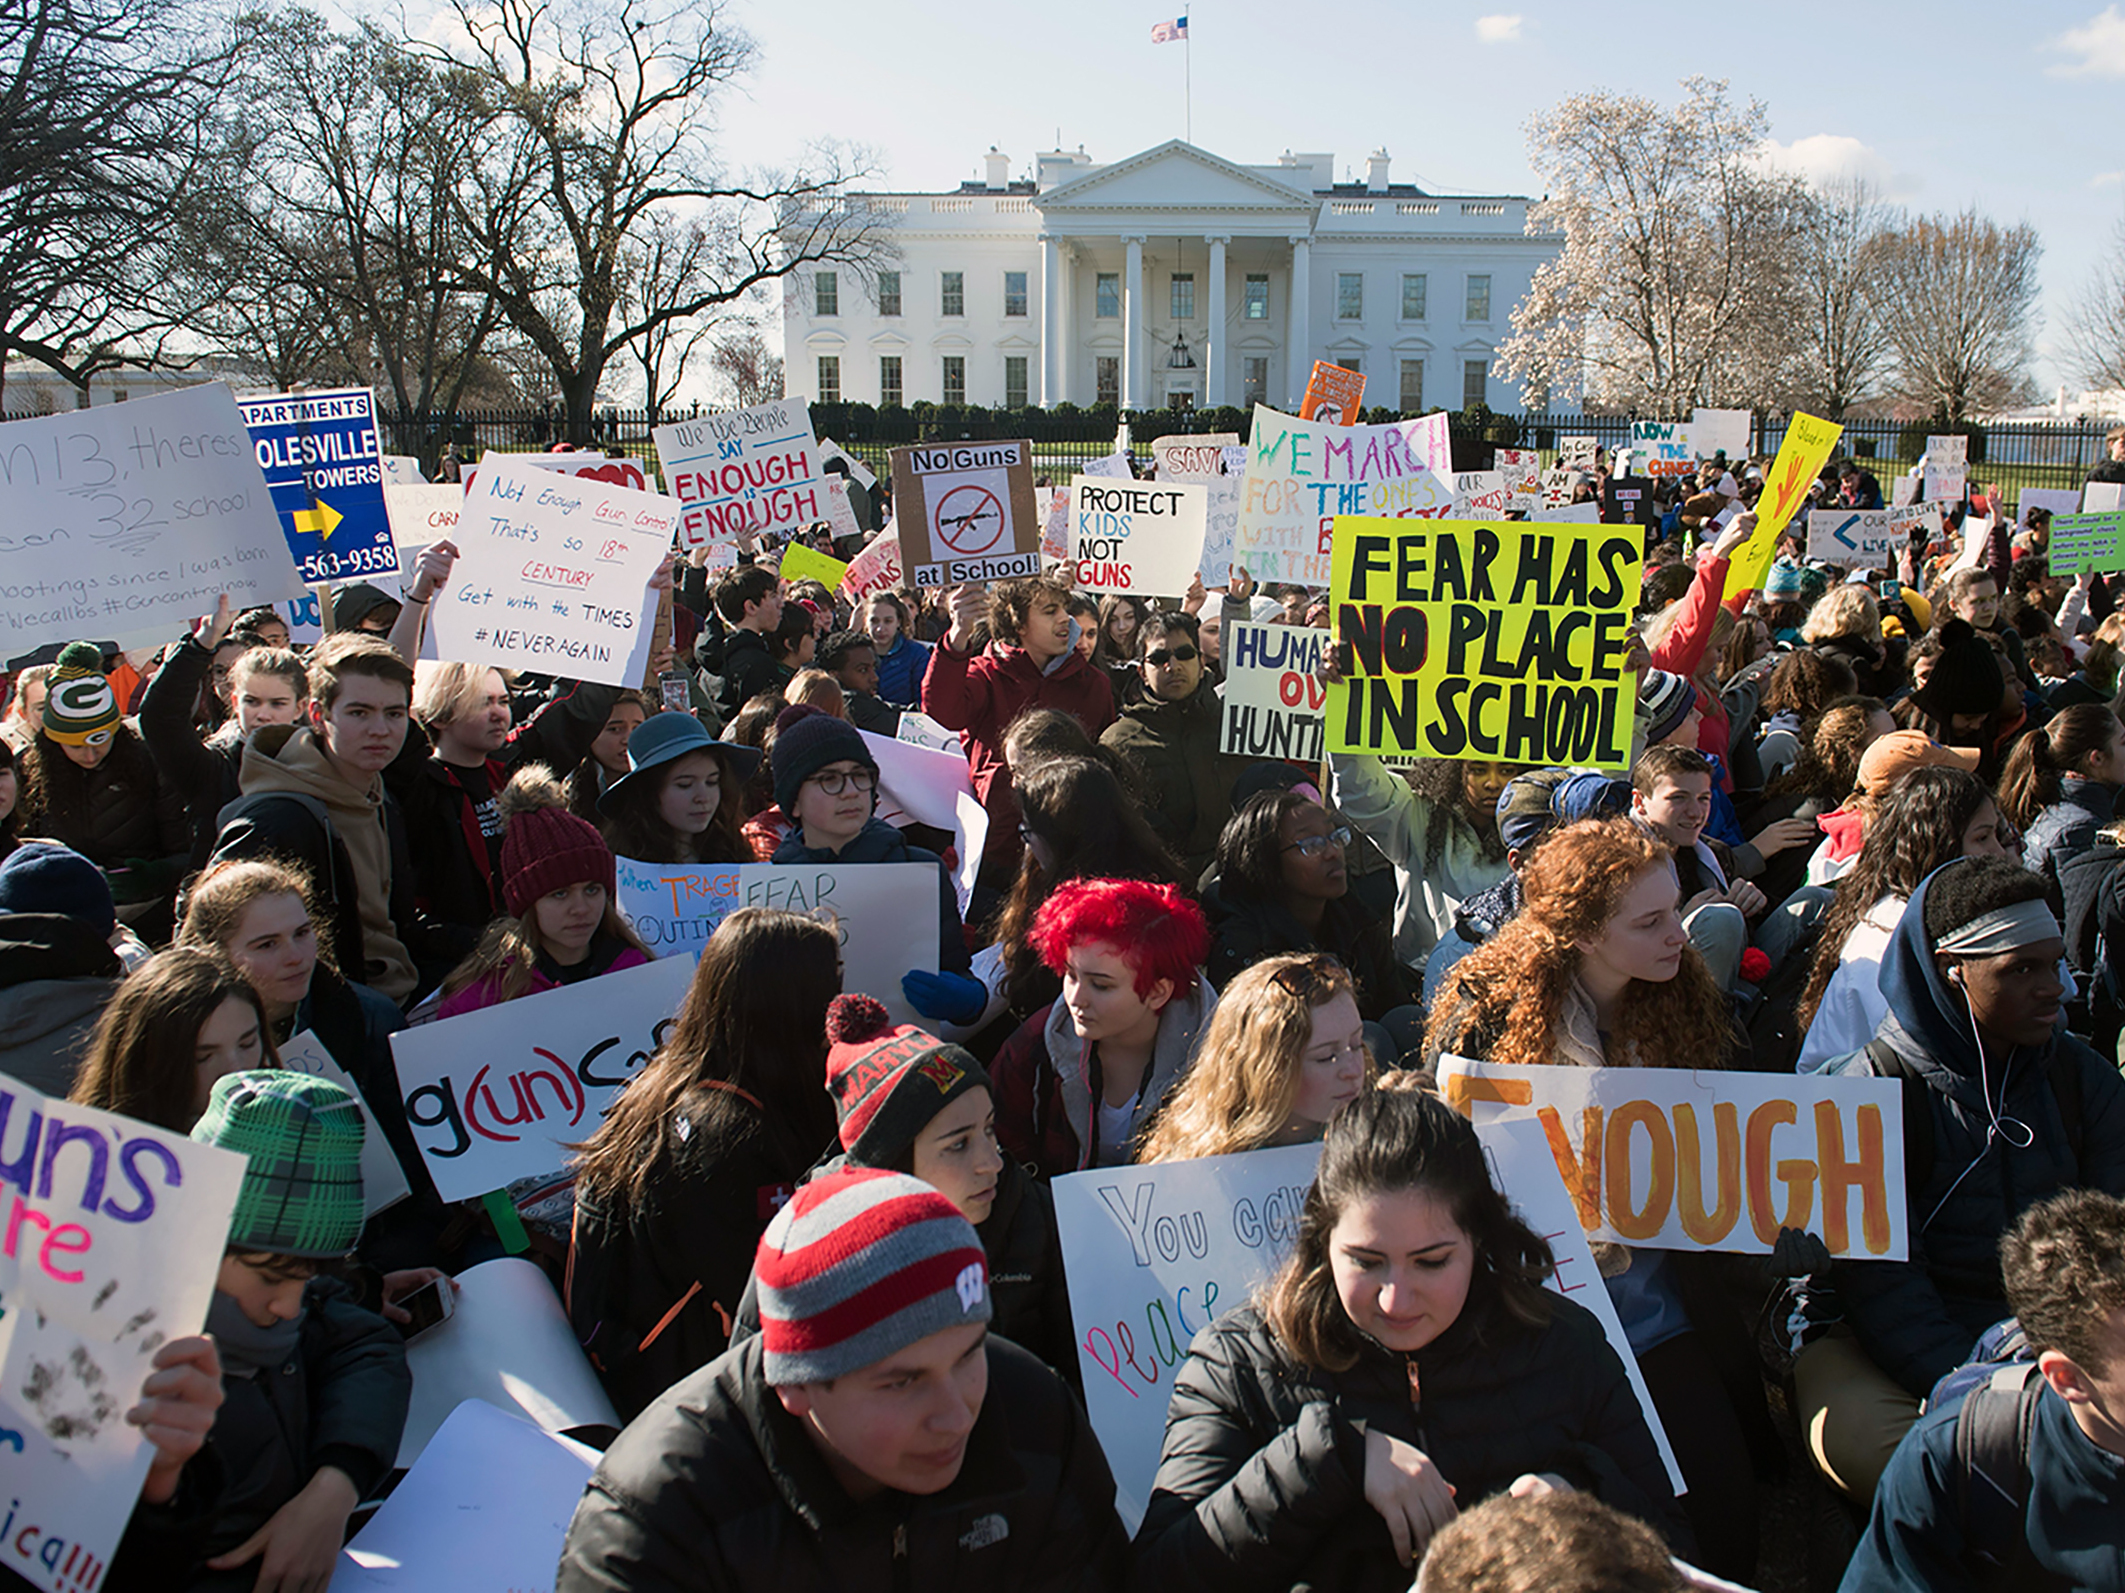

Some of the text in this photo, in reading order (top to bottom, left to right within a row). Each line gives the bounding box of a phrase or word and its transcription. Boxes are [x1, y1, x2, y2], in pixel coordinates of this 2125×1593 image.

[675, 425, 704, 448] We
[737, 405, 790, 435] People
[1634, 422, 1675, 440] NOW
[129, 426, 242, 469] theres
[255, 430, 378, 469] OLESVILLE
[717, 439, 743, 460] SAY
[912, 449, 1017, 471] No Guns
[1256, 422, 1311, 476] WE
[1325, 416, 1447, 480] MARCH
[302, 464, 381, 490] TOWERS
[675, 451, 810, 503] ENOUGH
[1548, 473, 1569, 487] AM
[1648, 459, 1698, 476] CHANGE
[489, 476, 526, 502] Not
[537, 488, 582, 515] Enough
[595, 500, 627, 520] Gun
[1246, 478, 1303, 516] FOR
[1307, 483, 1368, 515] THE
[1372, 478, 1436, 510] ONES
[1458, 474, 1485, 492] OUR
[1550, 490, 1561, 501] I
[89, 494, 169, 541] 32
[173, 489, 251, 521] school
[1080, 485, 1184, 516] PROTECT
[1470, 489, 1503, 512] VOICES
[1915, 502, 1937, 515] LIVE
[683, 488, 818, 544] ENOUGH
[1079, 513, 1132, 537] KIDS
[1863, 515, 1887, 527] OUR
[2078, 516, 2100, 524] should
[490, 516, 629, 560] That's so 18th
[1243, 525, 1303, 547] WITH
[1863, 539, 1888, 553] LIVE
[2053, 528, 2092, 537] background
[296, 545, 396, 578] -563-9358
[1078, 538, 1123, 561] NOT
[1240, 550, 1279, 578] IN
[2053, 551, 2078, 559] allowed
[2093, 549, 2106, 557] buy
[107, 570, 170, 587] since
[180, 562, 185, 579] I
[191, 556, 232, 574] was
[235, 546, 270, 564] born
[521, 560, 595, 588] CENTURY
[917, 566, 939, 585] at
[952, 555, 1038, 581] School!
[1349, 529, 1500, 602] FEAR
[1510, 533, 1640, 608] HAS
[0, 606, 98, 630] Wecallbs
[458, 583, 633, 629] Get with the TIMES
[1338, 603, 1628, 681] NO PLACE
[50, 676, 113, 719] G
[1345, 677, 1624, 764] IN SCHOOL
[85, 730, 111, 746] G
[660, 874, 740, 917] TRAGE
[918, 1054, 966, 1095] M
[0, 1183, 92, 1283] re
[1098, 1182, 1208, 1267] You
[956, 1262, 985, 1314] W
[995, 1272, 1032, 1284] Columbia
